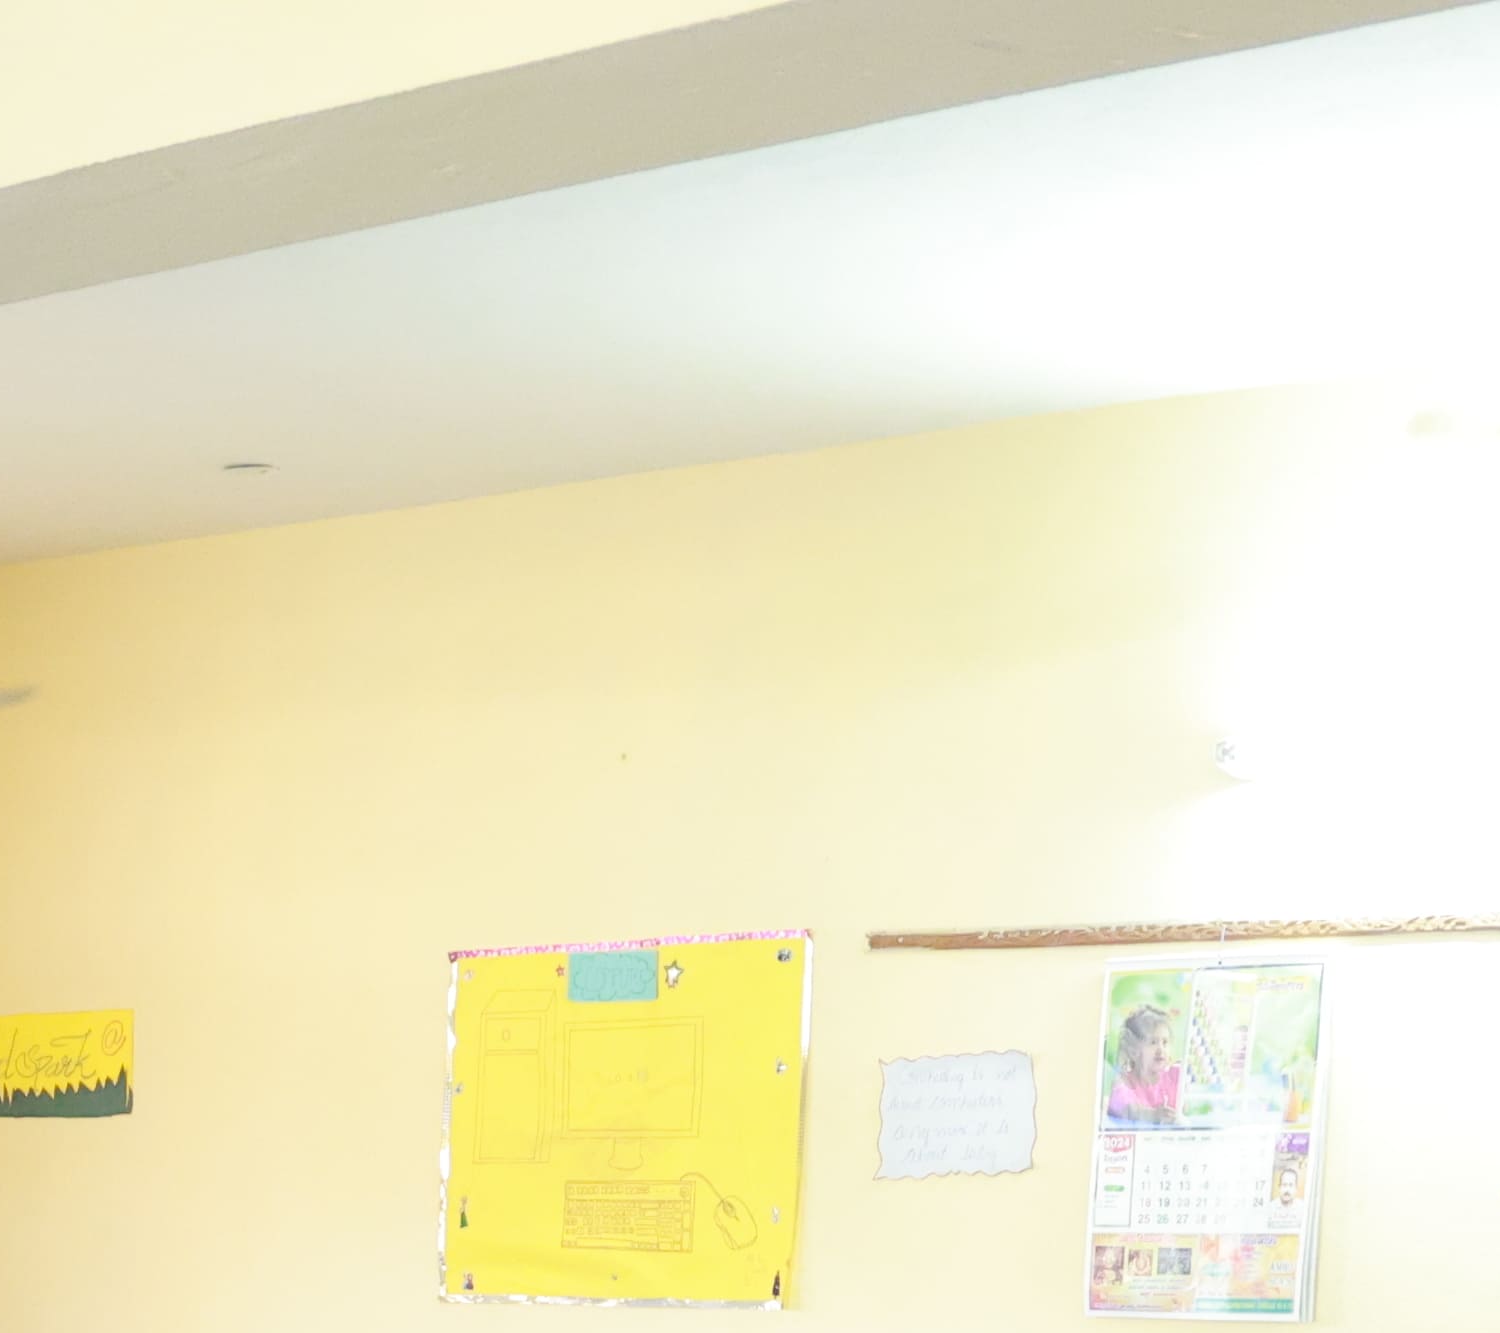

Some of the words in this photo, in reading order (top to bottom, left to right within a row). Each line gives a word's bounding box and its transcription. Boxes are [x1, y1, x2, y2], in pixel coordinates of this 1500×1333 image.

[15, 1028, 97, 1090] Spark
[1162, 1164, 1169, 1175] 5
[1182, 1164, 1189, 1175] 6
[1160, 1181, 1171, 1191] 12
[1179, 1181, 1191, 1191] 13
[1138, 1214, 1151, 1225] 25
[1176, 1213, 1189, 1225] 27
